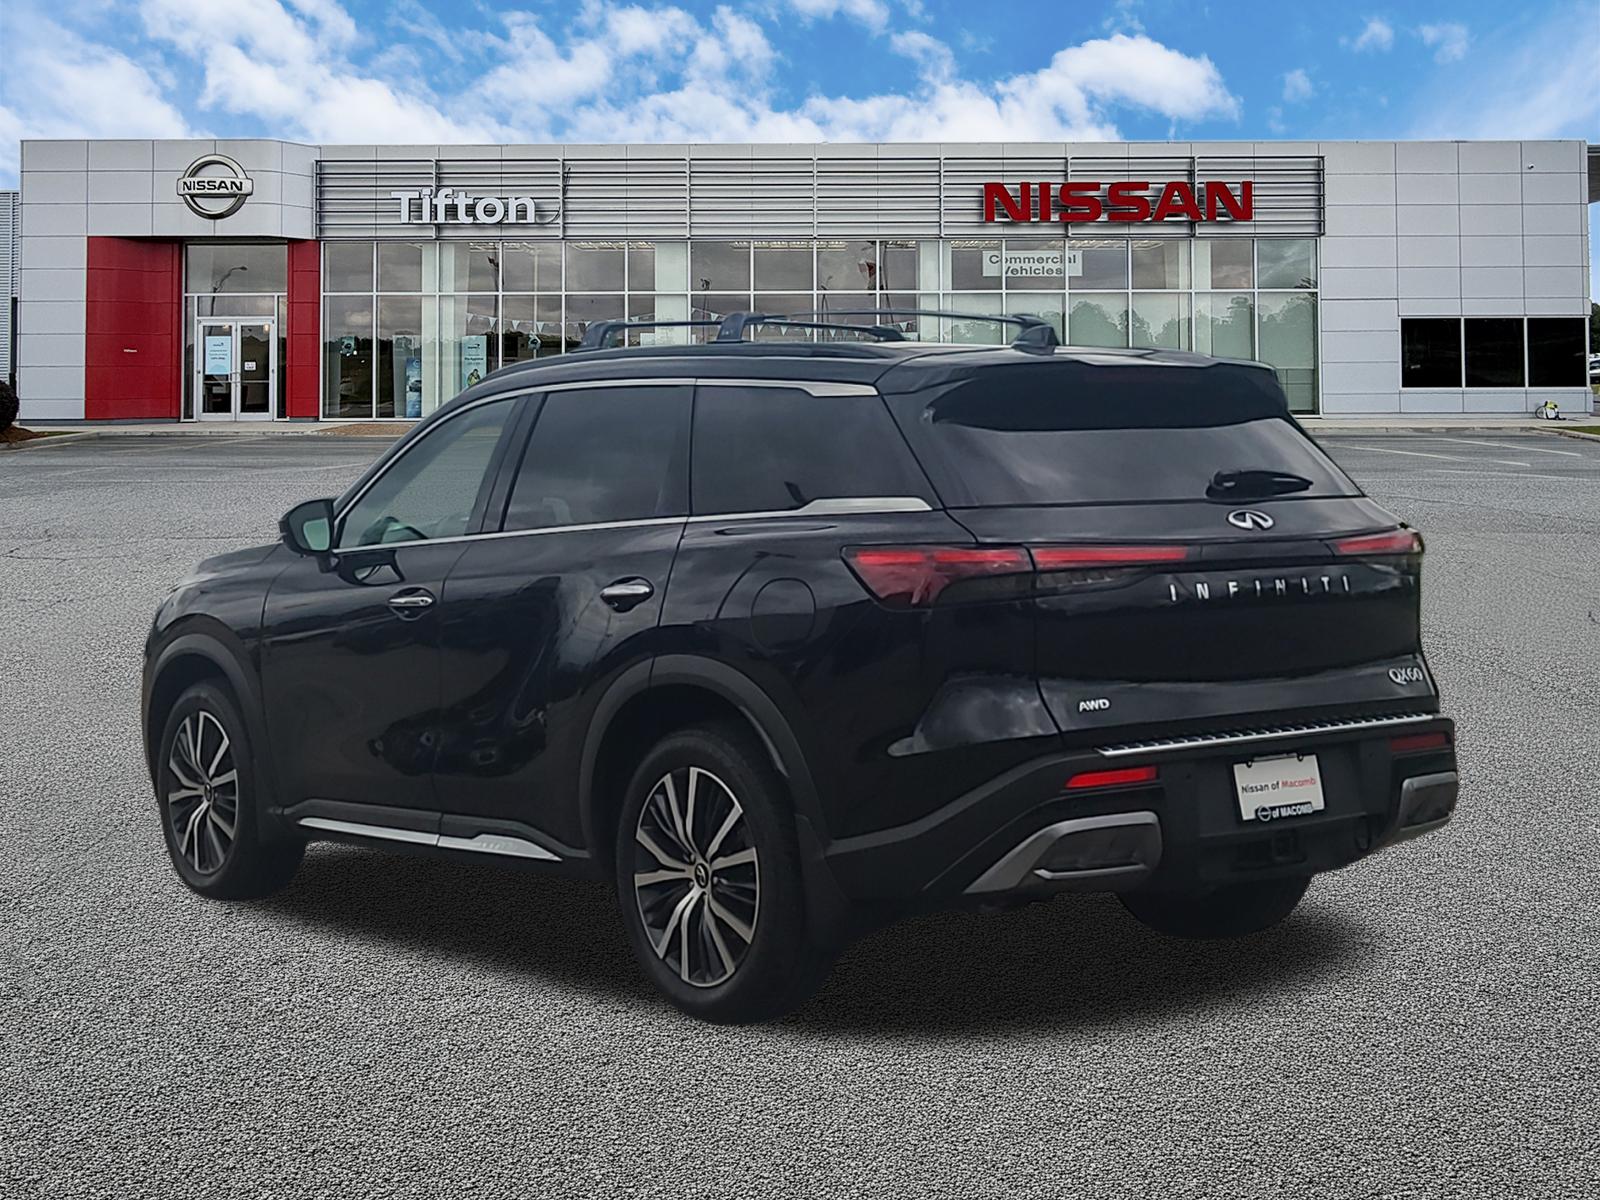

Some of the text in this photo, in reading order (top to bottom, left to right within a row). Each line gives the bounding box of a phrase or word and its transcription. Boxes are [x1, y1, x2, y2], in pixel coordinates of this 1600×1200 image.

[183, 180, 243, 191] NISSAN
[390, 188, 536, 224] Tifton
[983, 180, 1254, 223] NISSAN
[1169, 575, 1351, 602] INFINITI
[1388, 667, 1424, 685] QX60
[1079, 698, 1110, 712] AWD
[1242, 777, 1316, 793] Nissan of Macomb
[1272, 803, 1313, 818] of MACOMB
